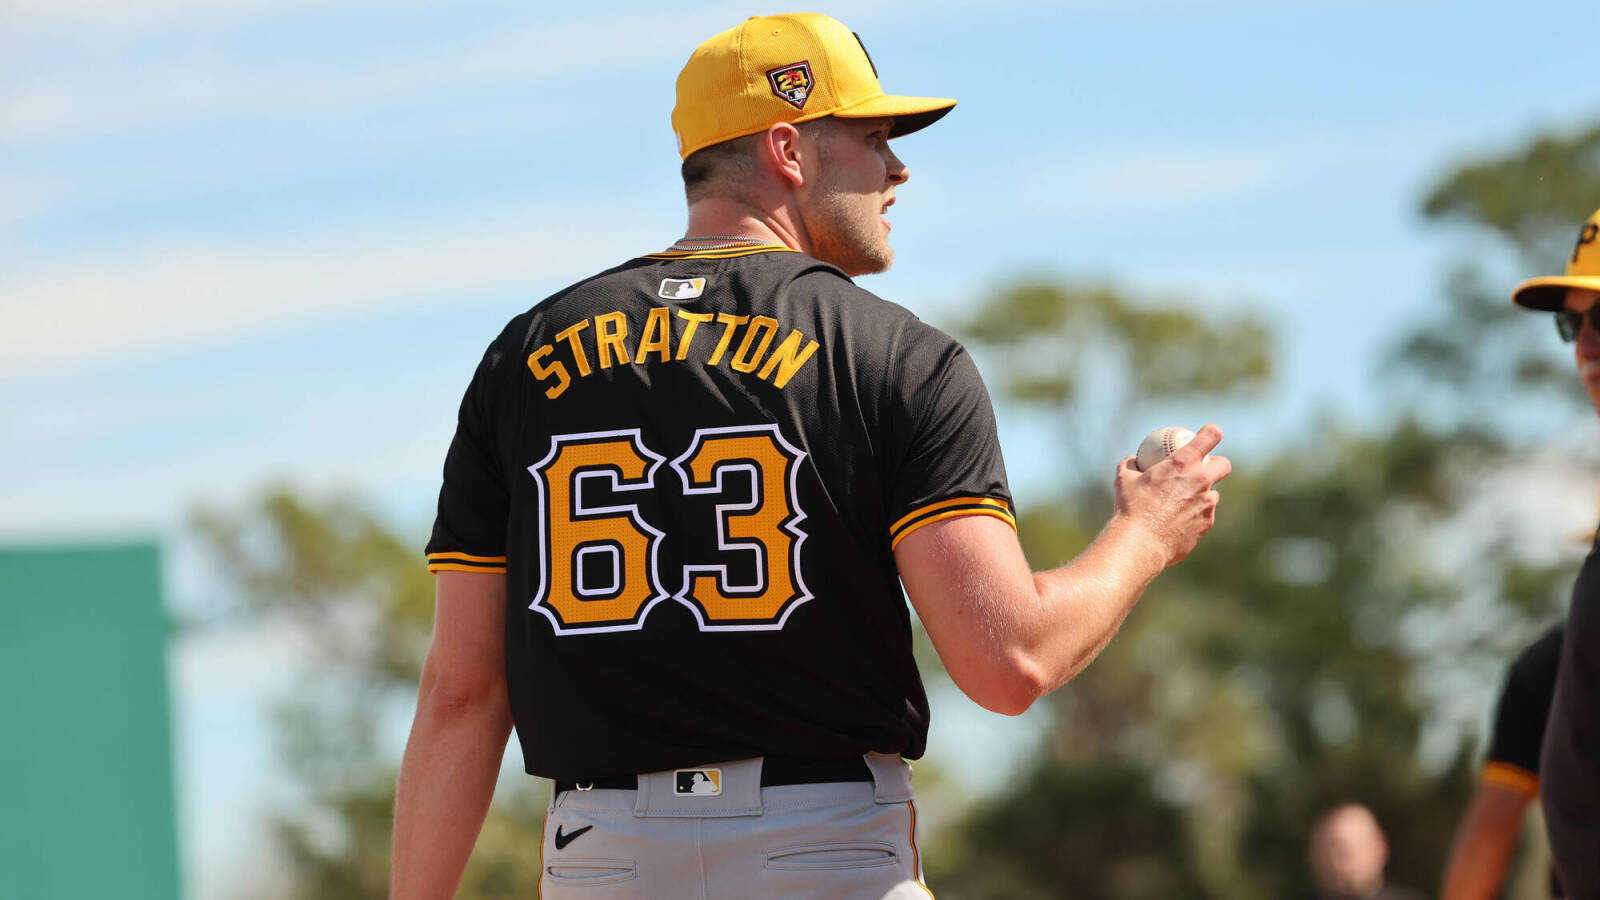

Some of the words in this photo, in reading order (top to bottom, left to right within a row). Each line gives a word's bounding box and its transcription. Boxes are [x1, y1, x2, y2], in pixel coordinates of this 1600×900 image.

[777, 70, 808, 91] 24
[527, 307, 820, 399] STRATTON
[527, 423, 815, 636] 63
